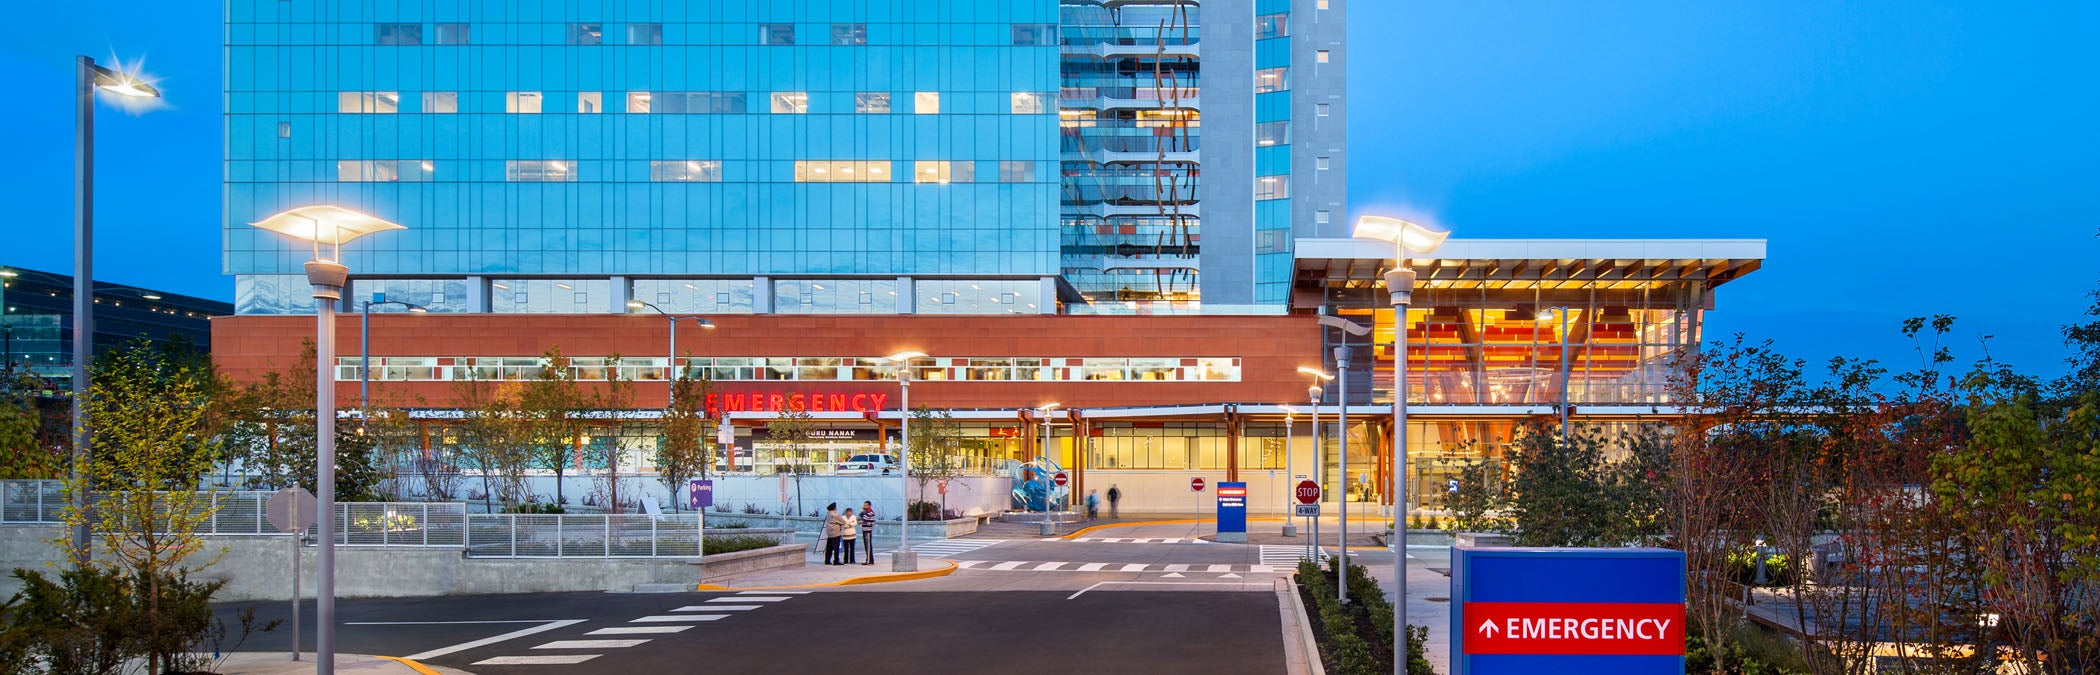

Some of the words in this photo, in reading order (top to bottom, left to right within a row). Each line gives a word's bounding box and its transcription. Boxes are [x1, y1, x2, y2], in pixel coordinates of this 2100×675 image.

[705, 393, 887, 412] EMERGENCY
[1298, 487, 1318, 497] STOP
[1507, 618, 1671, 640] EMERGENCY
